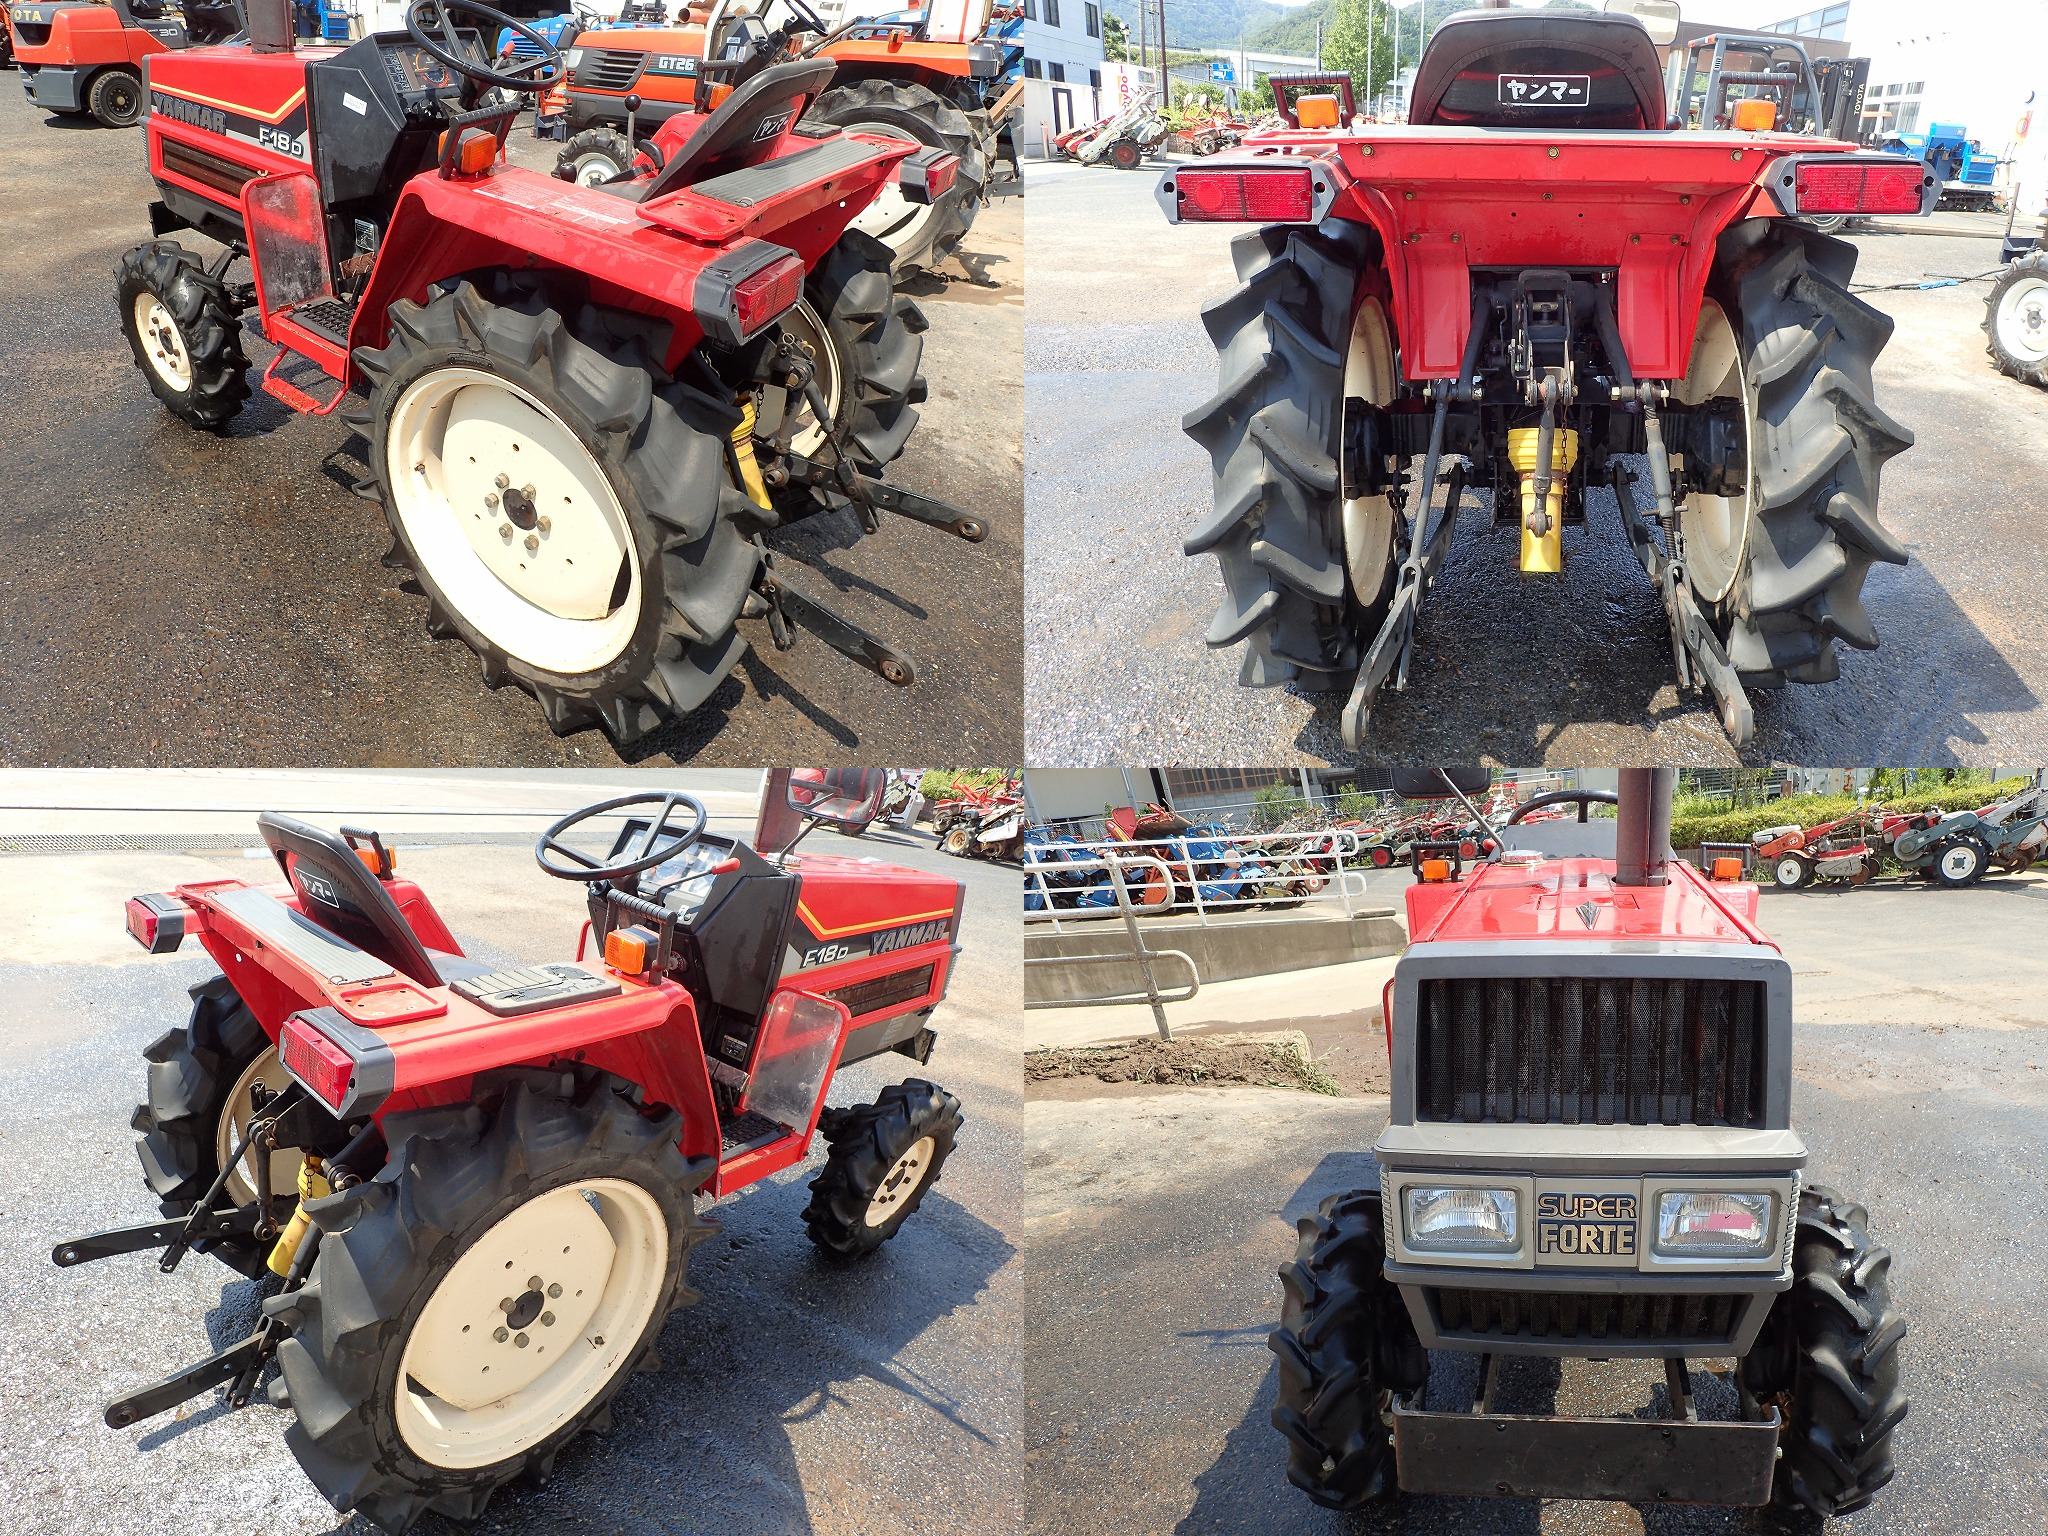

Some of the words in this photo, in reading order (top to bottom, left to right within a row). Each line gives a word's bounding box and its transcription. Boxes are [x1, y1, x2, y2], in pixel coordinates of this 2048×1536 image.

[159, 28, 178, 37] 30
[658, 56, 695, 71] GT26
[1506, 80, 1581, 100] ヤンマー
[1853, 83, 1865, 116] TOYOTA
[152, 92, 227, 137] YANMAR
[259, 126, 303, 156] F18D
[870, 921, 947, 956] YANMAR
[801, 945, 849, 968] F18D
[1539, 1194, 1637, 1218] SUPER
[1539, 1222, 1636, 1254] FORTE
